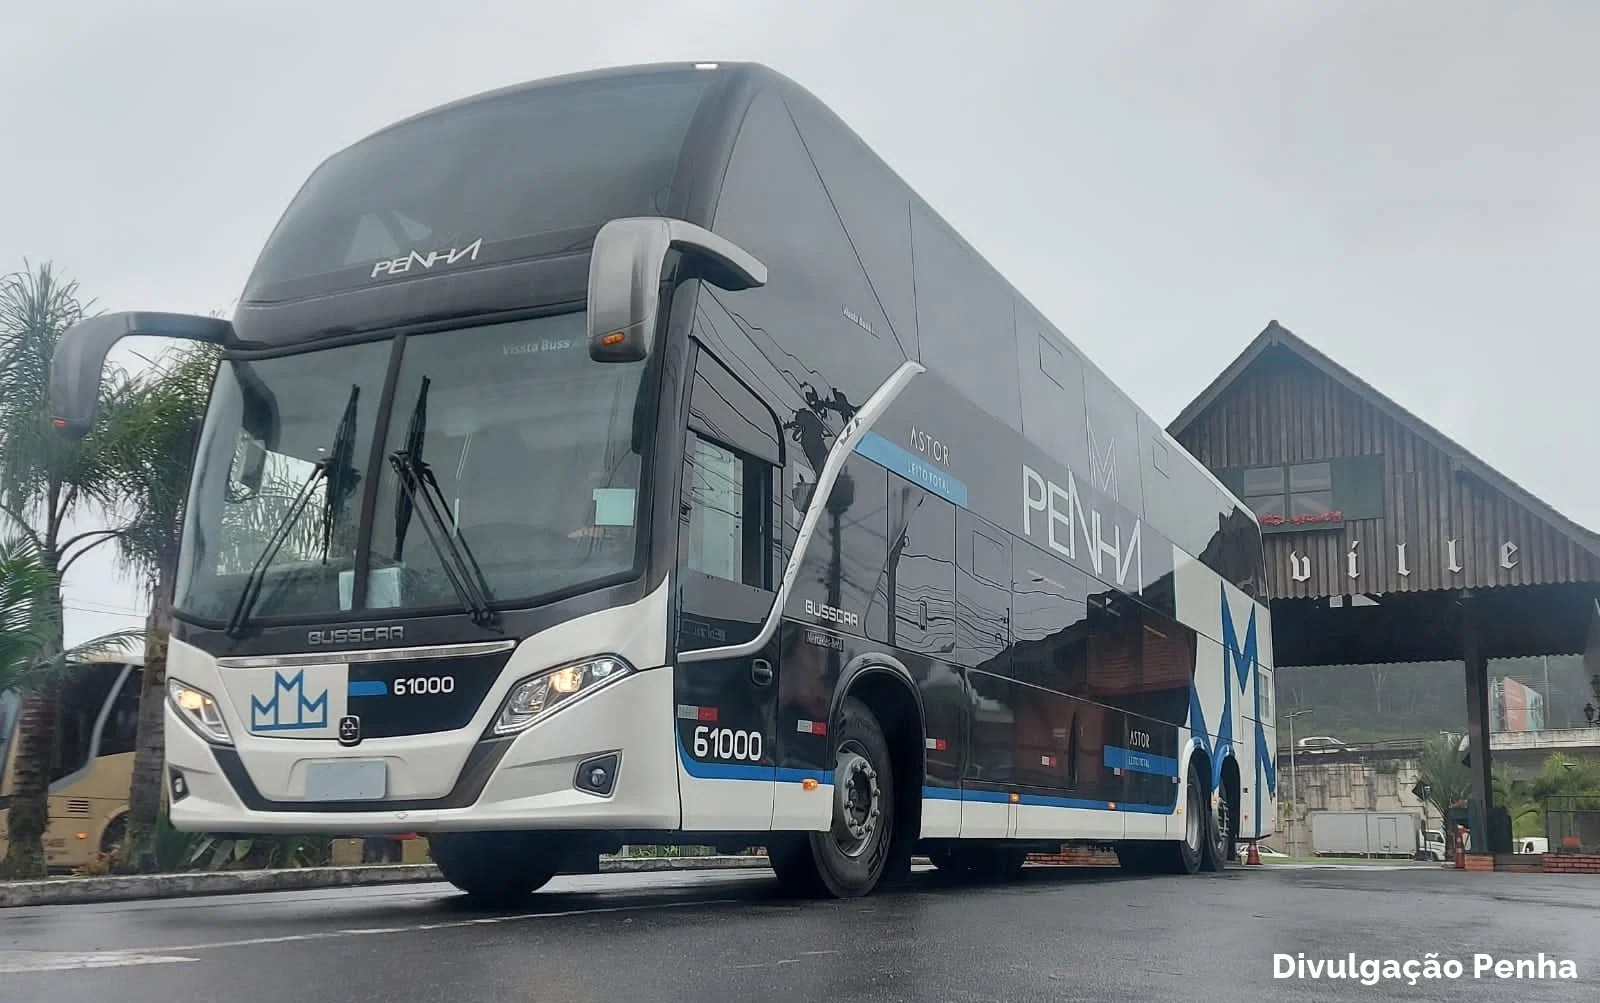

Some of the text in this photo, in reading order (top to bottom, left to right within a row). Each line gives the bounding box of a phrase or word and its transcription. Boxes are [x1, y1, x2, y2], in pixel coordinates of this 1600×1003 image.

[371, 238, 482, 278] PENHA
[910, 425, 950, 467] ASTOR
[1021, 462, 1143, 597] PENHA
[805, 599, 858, 627] BUSSCAR
[308, 626, 404, 645] BUSSCAR
[393, 676, 455, 696] 61000
[693, 725, 762, 761] 61000
[1129, 729, 1150, 749] ASTOR
